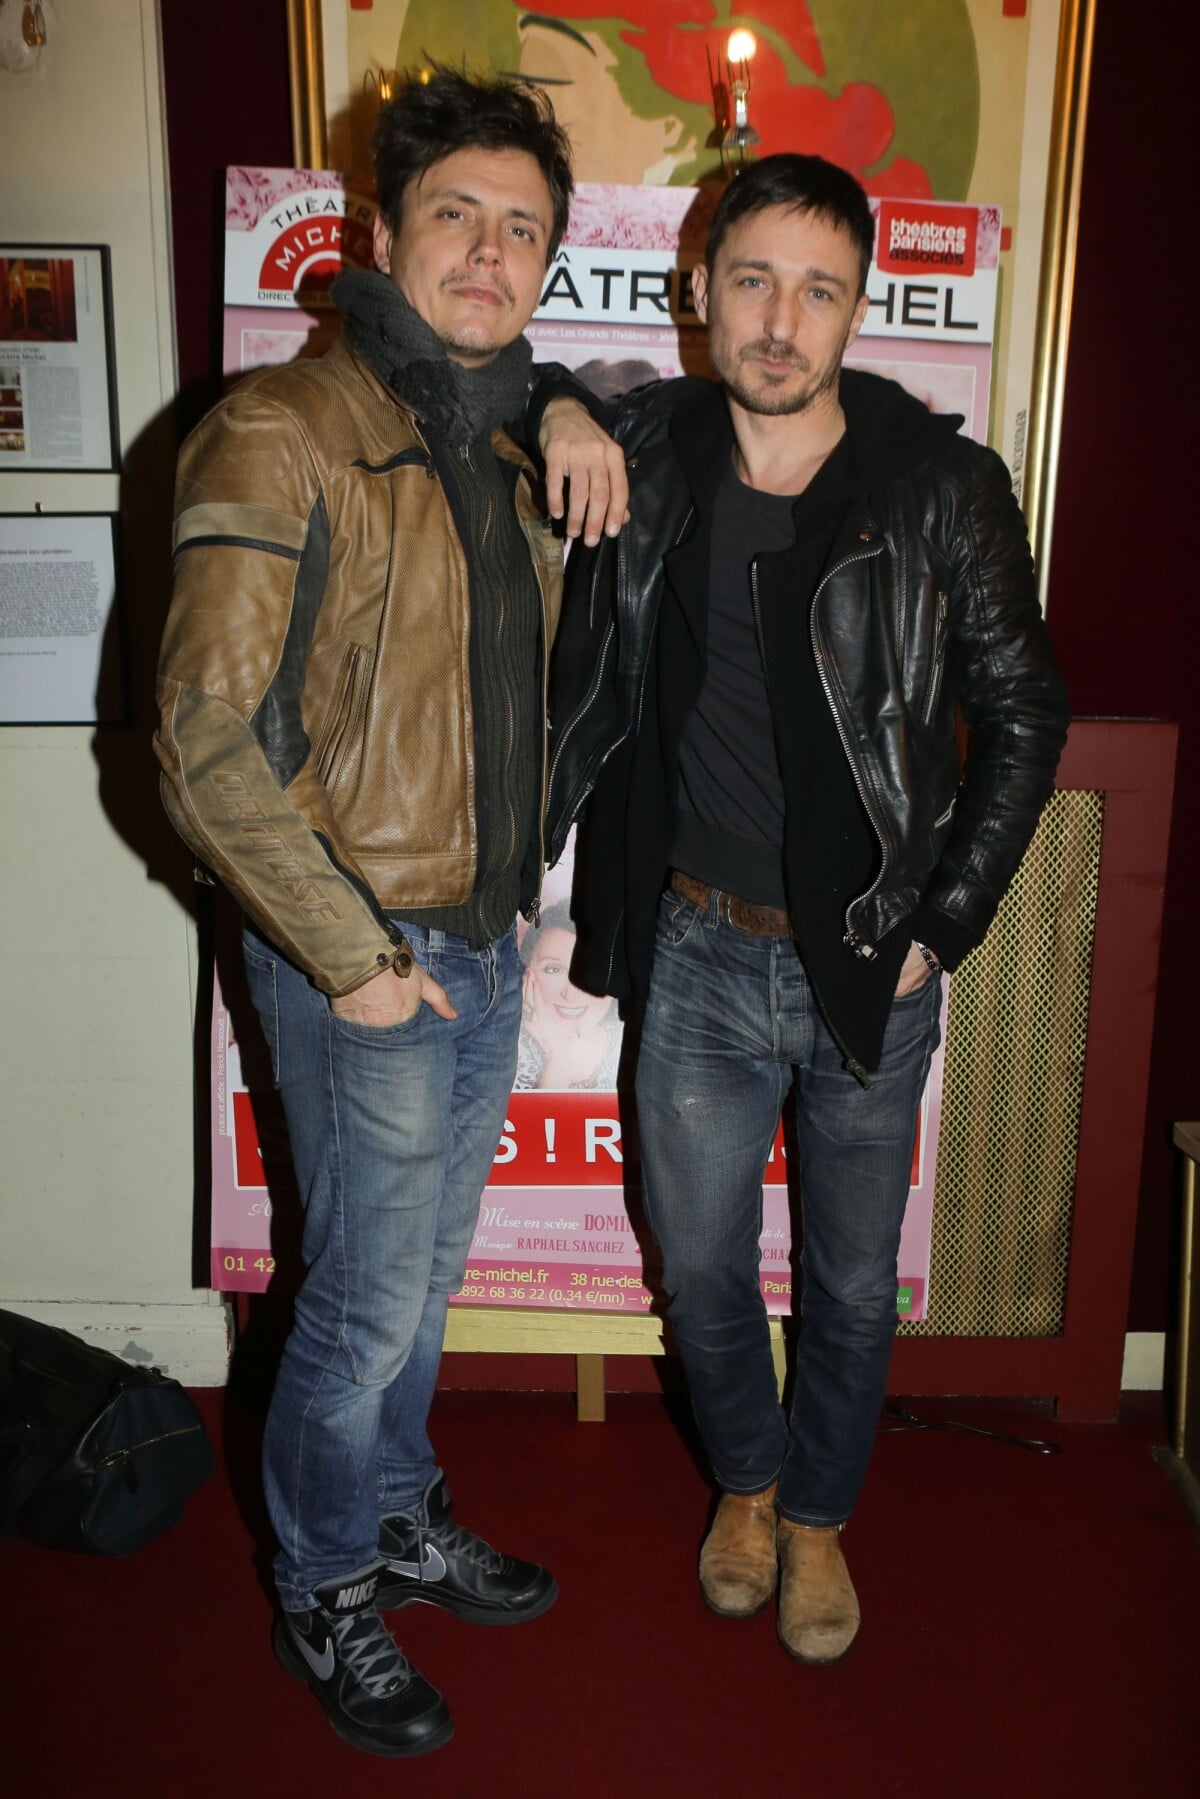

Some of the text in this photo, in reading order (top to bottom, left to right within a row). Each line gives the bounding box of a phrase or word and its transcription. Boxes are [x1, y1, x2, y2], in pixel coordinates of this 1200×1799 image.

[560, 326, 576, 338] Les
[577, 327, 609, 340] Grands
[544, 1118, 556, 1163] !
[480, 1206, 521, 1228] Mise
[523, 1218, 541, 1229] en
[543, 1216, 580, 1231] scène
[517, 1237, 570, 1252] RAPHAEL
[572, 1239, 625, 1254] SANCHEZ
[223, 1255, 246, 1272] 01
[253, 1256, 276, 1273] 42
[464, 1267, 550, 1284] re-michel.fr
[570, 1272, 587, 1286] 38
[591, 1275, 614, 1288] rue
[618, 1274, 643, 1289] des
[489, 1286, 506, 1299] 68
[509, 1287, 526, 1300] 36
[528, 1288, 545, 1300] 22
[549, 1288, 582, 1303] (0.34
[585, 1289, 625, 1305] €/mn)
[335, 1575, 379, 1609] NIKE
